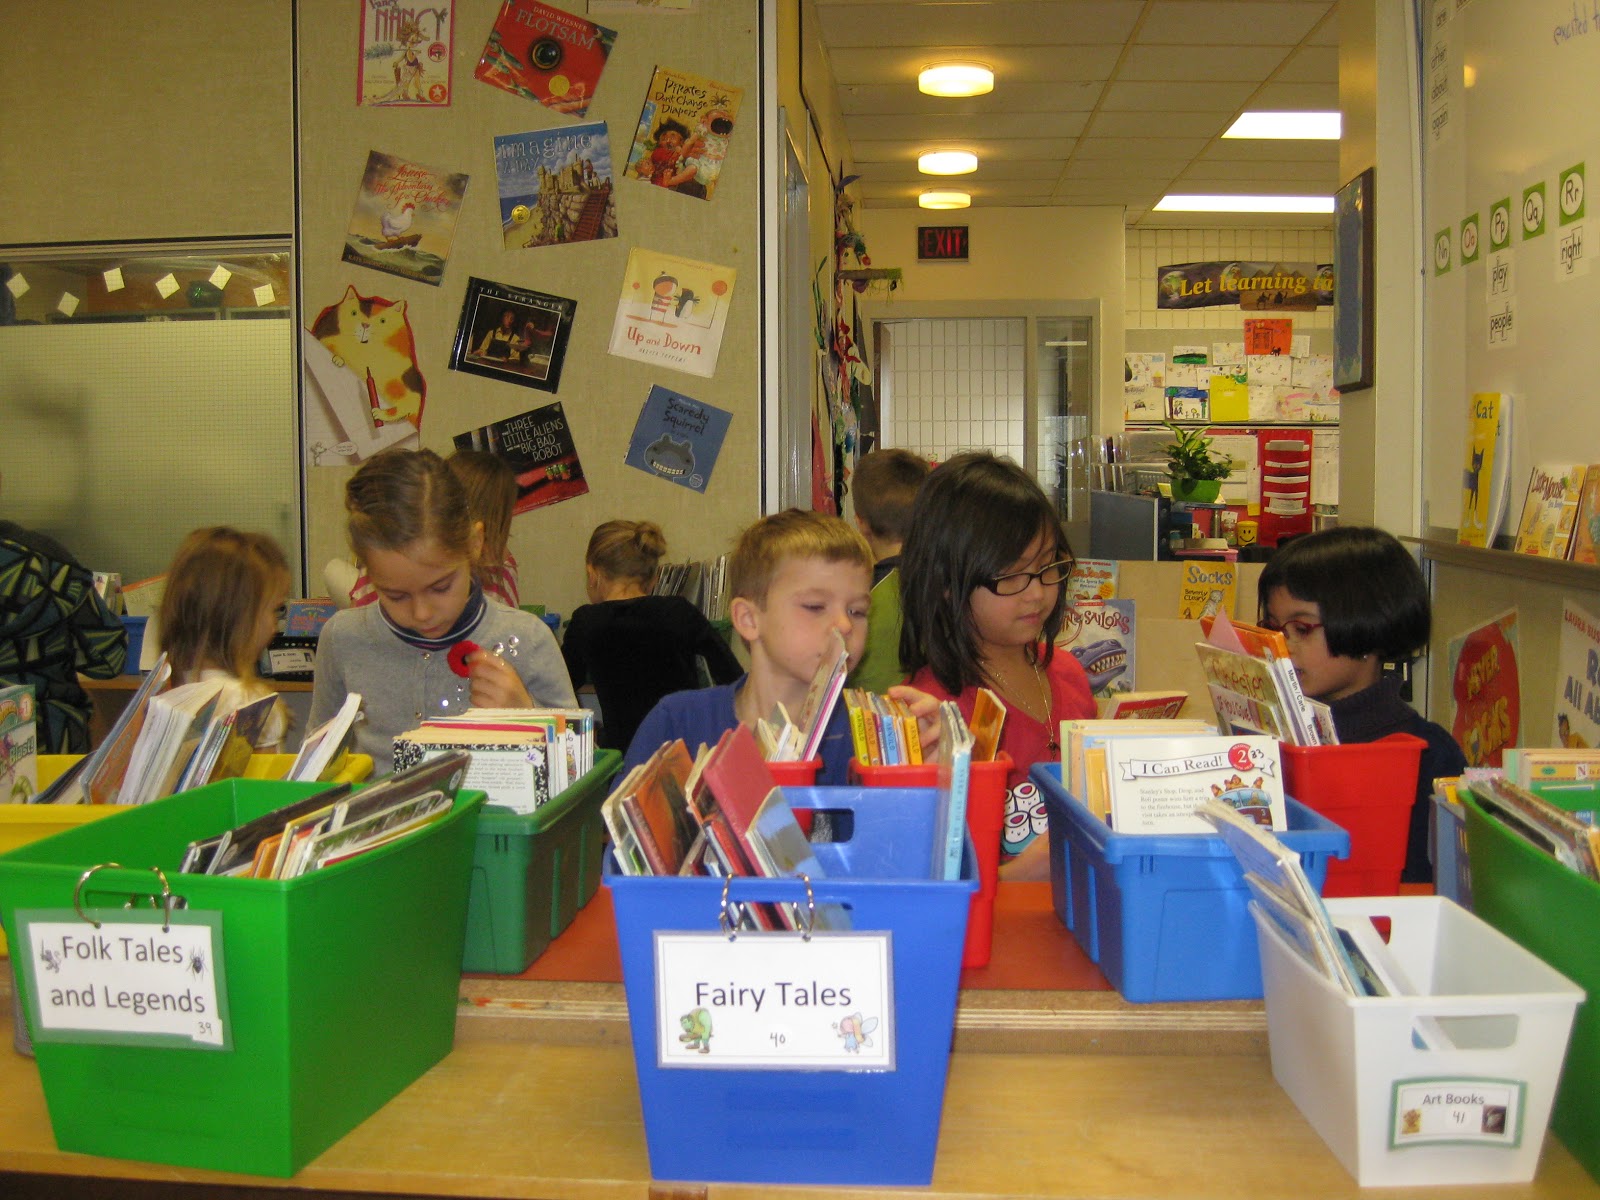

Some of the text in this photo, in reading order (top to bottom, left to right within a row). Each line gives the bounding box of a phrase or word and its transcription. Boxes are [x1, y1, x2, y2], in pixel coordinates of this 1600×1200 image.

[515, 9, 596, 50] FLOTSAM
[533, 6, 588, 32] DAVID WIESNER
[664, 77, 707, 99] Pirates
[662, 103, 697, 117] Diapers
[676, 94, 708, 110] Change
[501, 131, 592, 158] imagine
[1565, 179, 1579, 206] Rr
[1525, 198, 1539, 226] Qq
[1494, 212, 1505, 241] Pp
[924, 229, 964, 257] EXIT
[1561, 232, 1581, 270] right
[1180, 278, 1212, 297] Let
[1219, 272, 1307, 294] learning
[1492, 258, 1508, 291] play
[480, 287, 563, 311] THE STRANGER
[1490, 303, 1513, 340] people
[627, 326, 702, 354] Up and Down
[667, 398, 710, 424] Scaredy
[1476, 400, 1494, 419] Cat
[502, 418, 564, 448] LITTLE ALIENS
[505, 416, 535, 434] THREE
[663, 411, 706, 436] Squirrel
[520, 440, 537, 454] BIG
[537, 433, 556, 449] BAD
[532, 443, 563, 462] ROBOT
[1187, 565, 1233, 586] Socks
[1564, 608, 1585, 633] LAURA
[1563, 675, 1582, 711] All
[1287, 669, 1299, 691] Martin
[1296, 695, 1306, 713] Carle
[1306, 724, 1318, 745] Brown
[1142, 756, 1223, 774] I Can Read!
[1237, 749, 1247, 763] 2
[1578, 766, 1586, 776] N
[62, 935, 184, 964] Folk Tales
[51, 984, 206, 1015] and Legends
[696, 980, 852, 1013] Fairy Tales
[197, 1021, 213, 1036] 39
[769, 1032, 786, 1048] 40
[1422, 1093, 1485, 1105] Art Books
